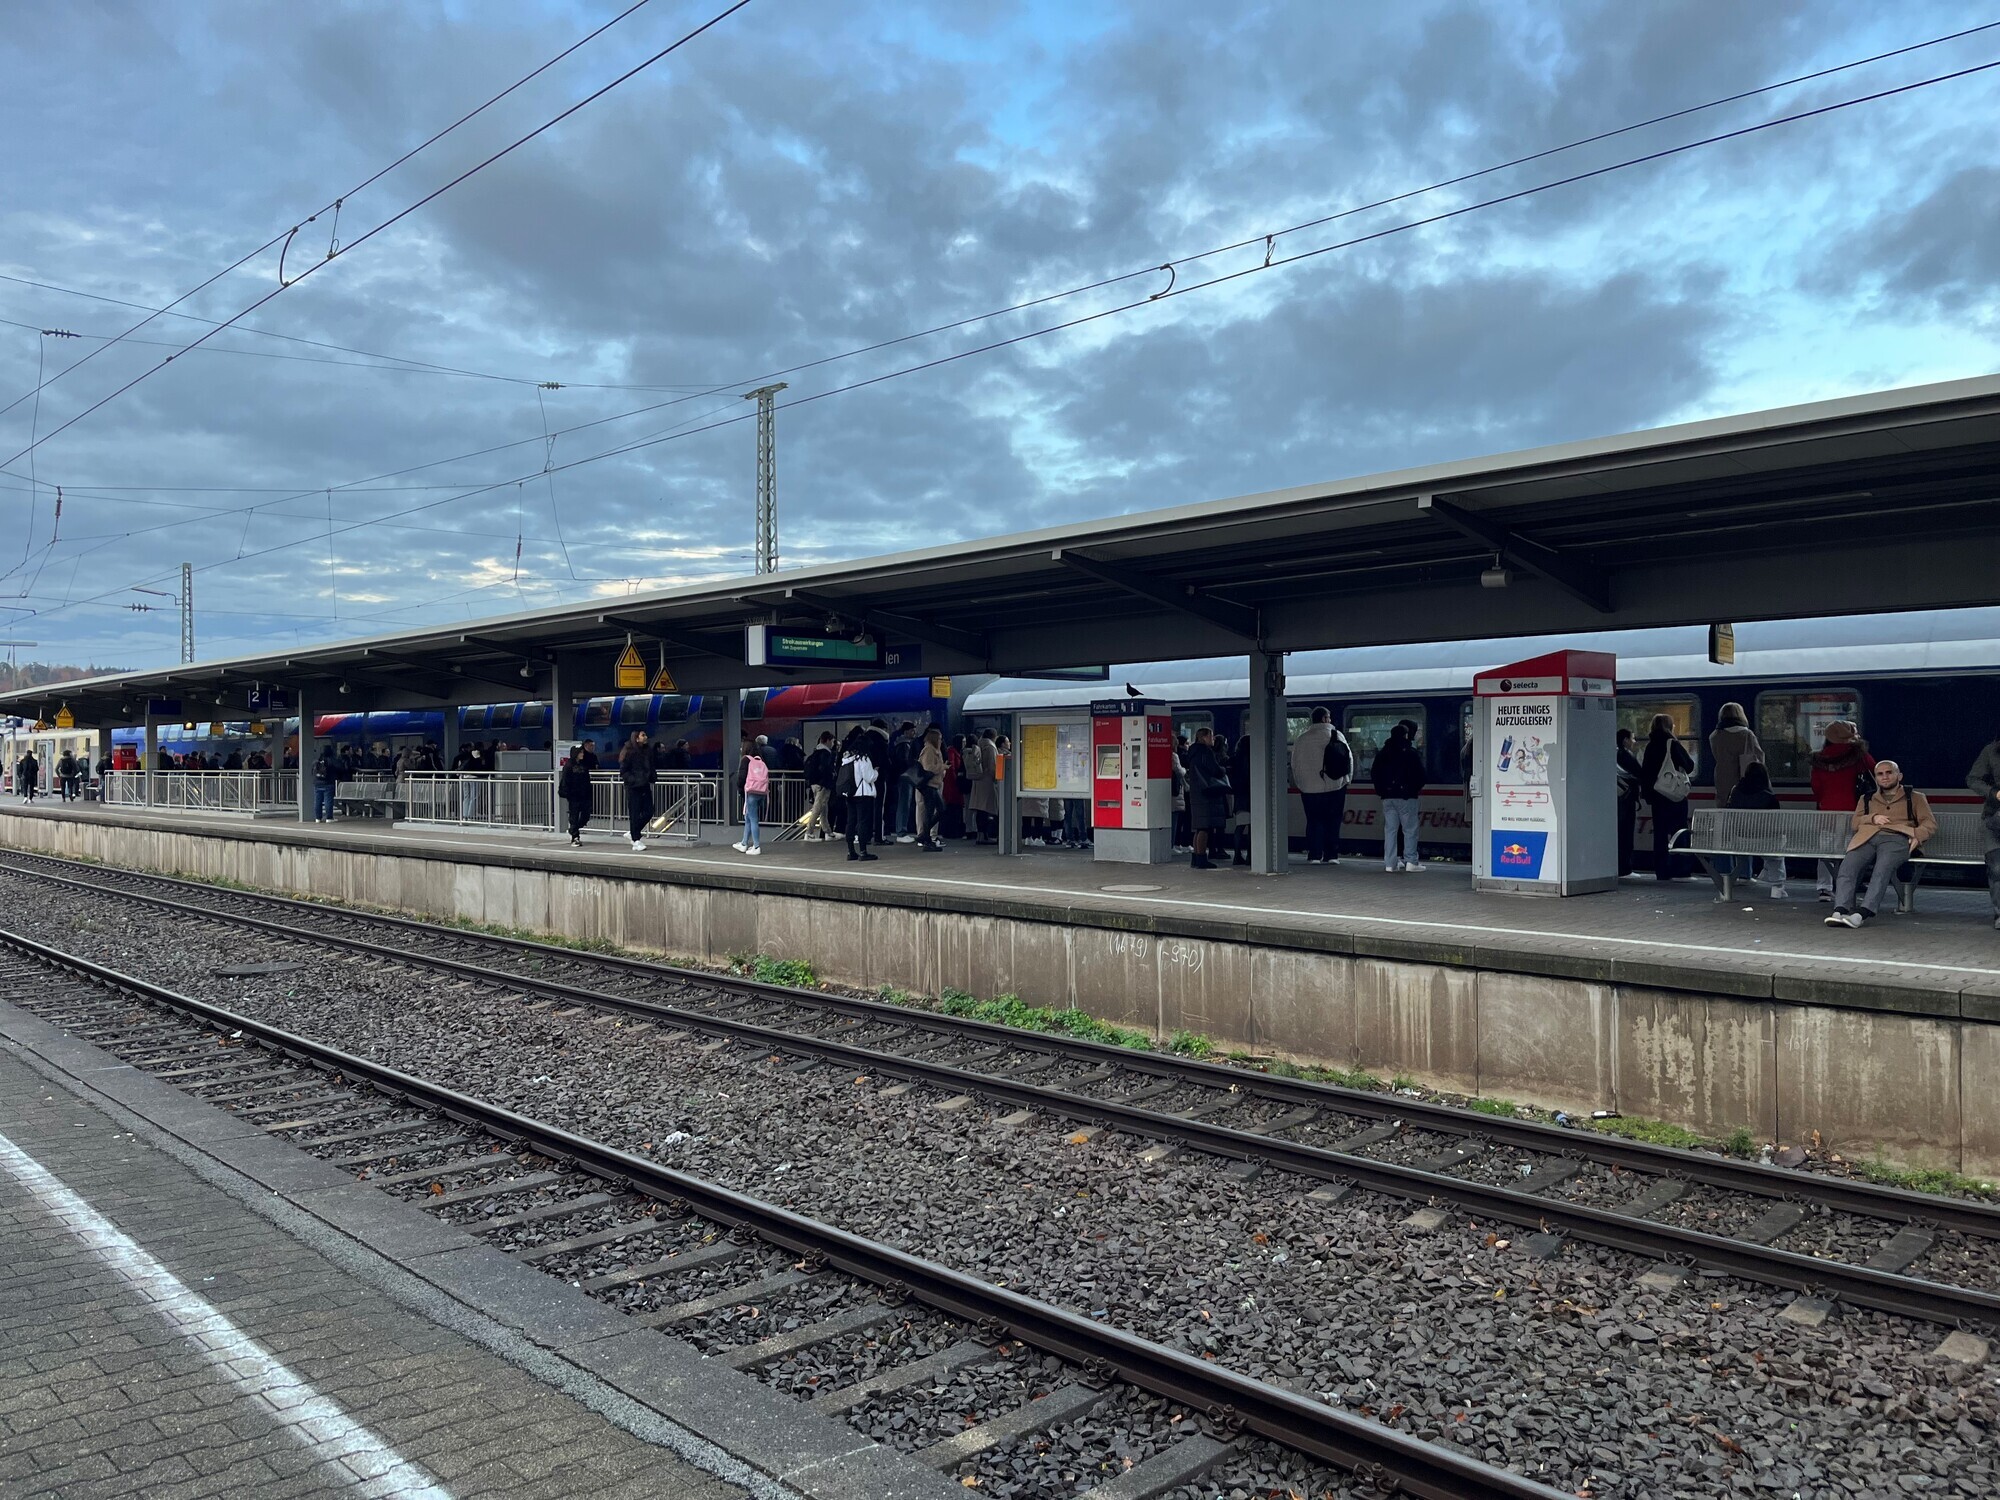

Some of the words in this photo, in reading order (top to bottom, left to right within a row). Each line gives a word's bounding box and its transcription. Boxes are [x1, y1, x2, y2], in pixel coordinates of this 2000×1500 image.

[885, 651, 900, 665] len
[1512, 681, 1539, 689] selecta
[251, 691, 260, 702] 2
[1498, 705, 1520, 715] HEUTE
[1522, 705, 1550, 715] EINIGES
[1495, 716, 1553, 726] AUFZUGLEISEN?
[1500, 854, 1516, 863] Red
[1516, 855, 1531, 864] Bull
